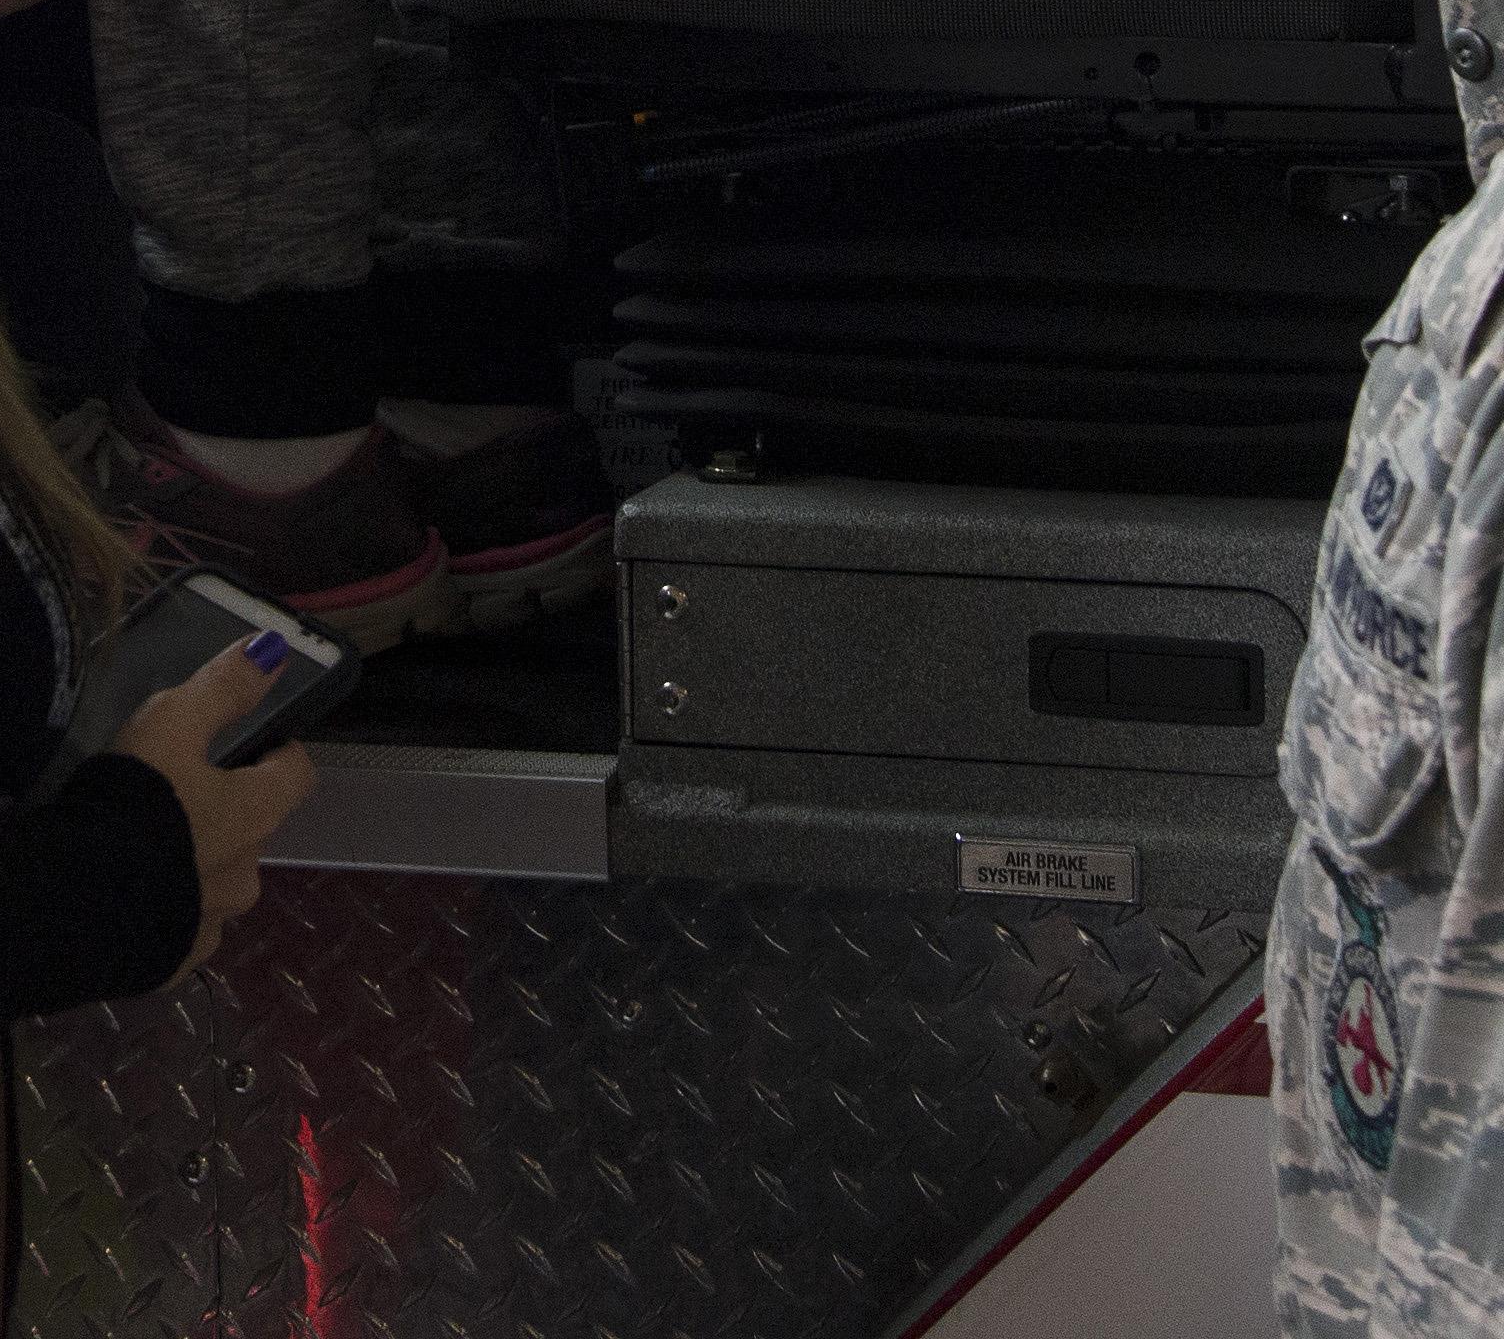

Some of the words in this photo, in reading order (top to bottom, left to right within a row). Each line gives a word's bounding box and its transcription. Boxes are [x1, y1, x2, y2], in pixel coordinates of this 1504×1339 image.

[1006, 851, 1031, 869] AIR
[1036, 852, 1088, 872] BRAKE
[977, 866, 1040, 886] SYSTEM
[1045, 871, 1077, 889] FILL
[1081, 873, 1116, 892] LINE
